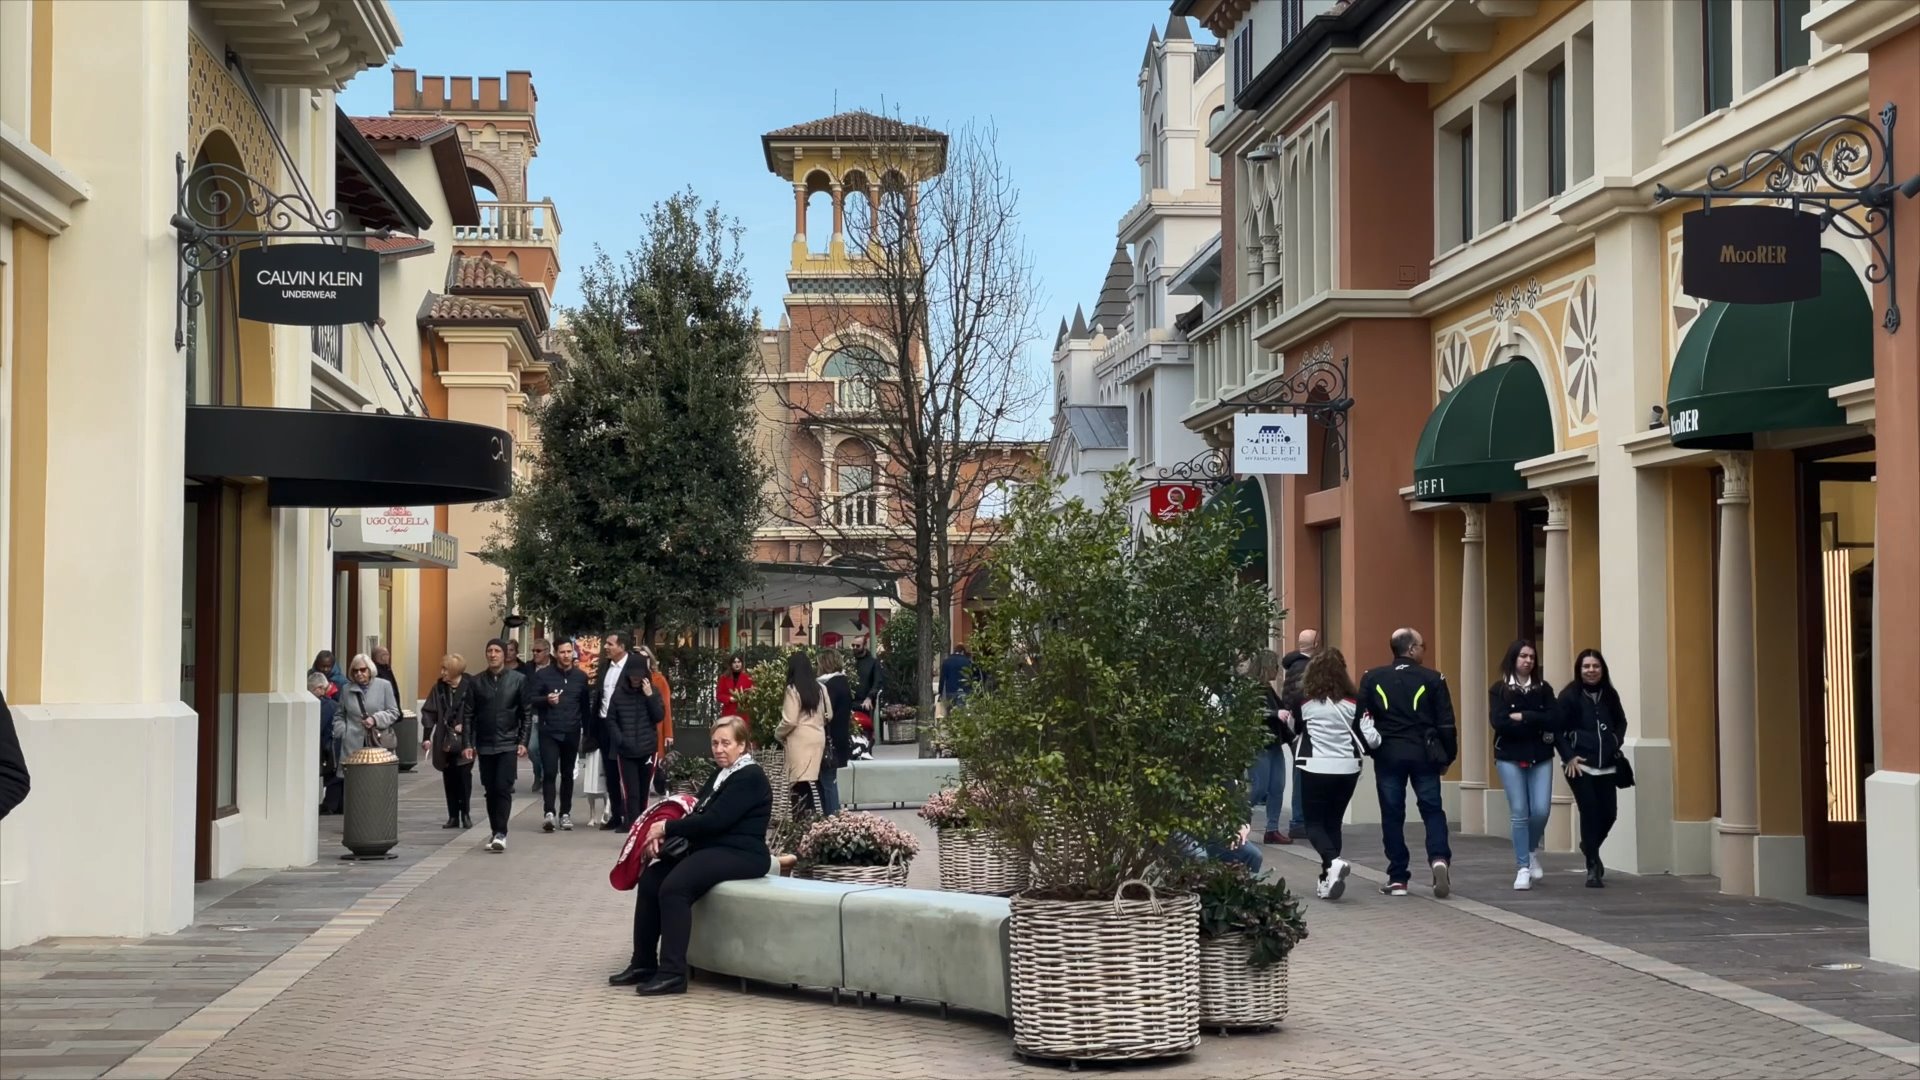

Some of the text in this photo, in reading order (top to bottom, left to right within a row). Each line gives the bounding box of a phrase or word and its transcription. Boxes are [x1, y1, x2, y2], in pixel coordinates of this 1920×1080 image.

[1720, 245, 1787, 263] MooRER
[256, 270, 363, 286] CALVIN KLEIN
[281, 290, 337, 299] UNDERWEAR
[1241, 446, 1301, 455] CALEFFI
[366, 517, 430, 525] UGO COLELLA
